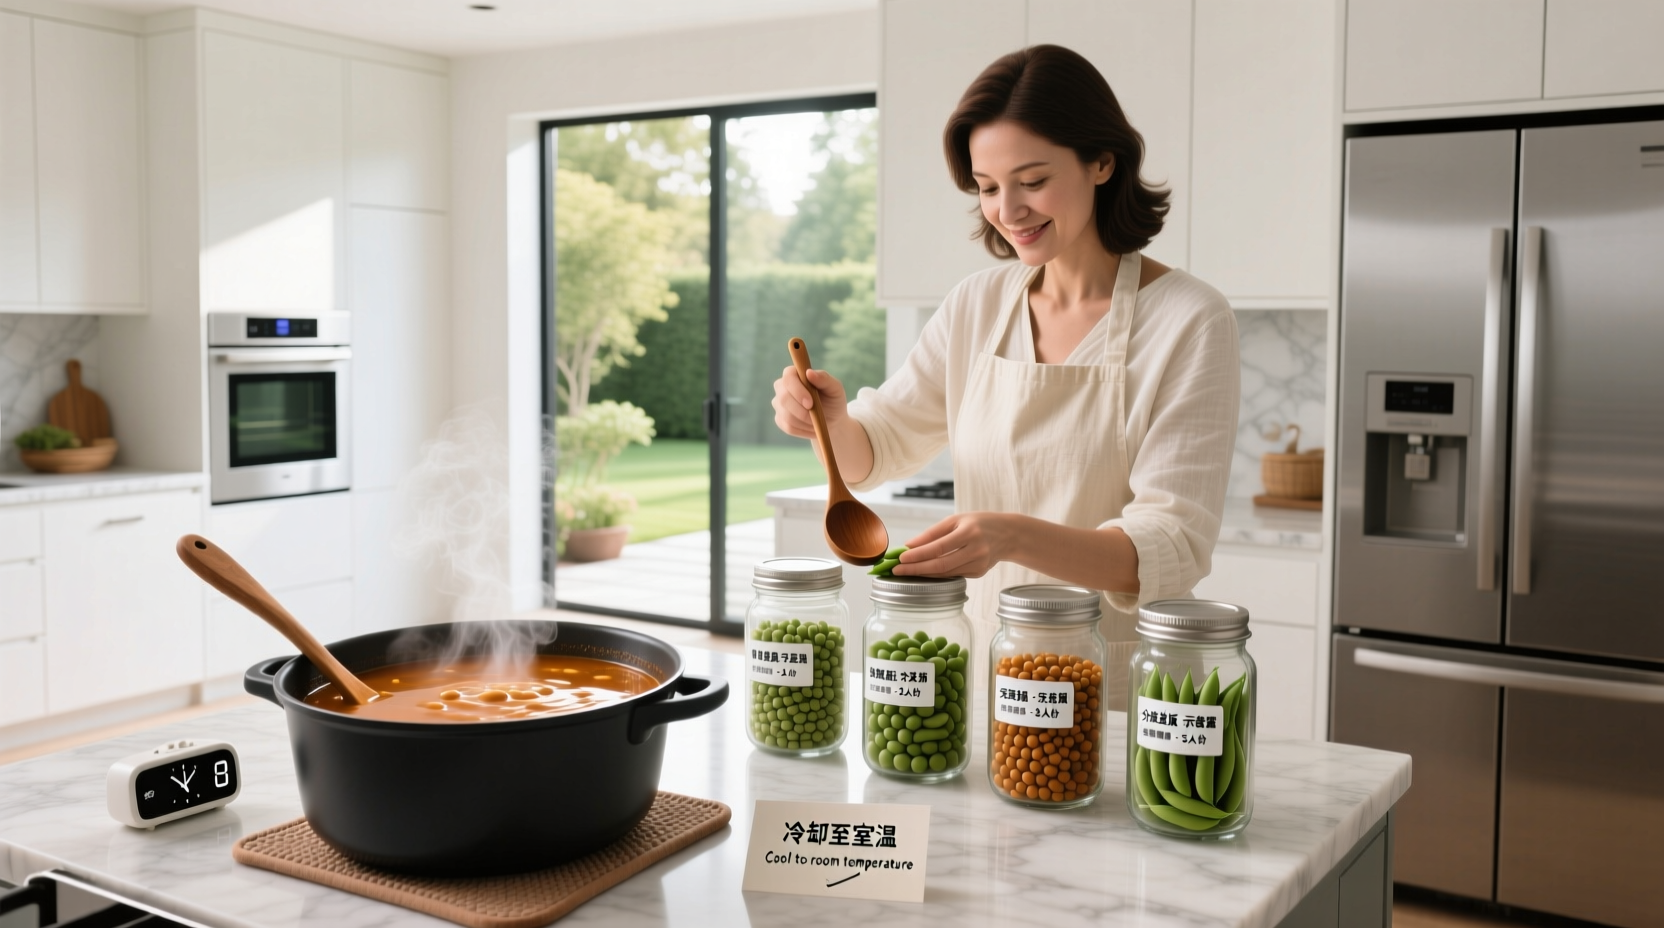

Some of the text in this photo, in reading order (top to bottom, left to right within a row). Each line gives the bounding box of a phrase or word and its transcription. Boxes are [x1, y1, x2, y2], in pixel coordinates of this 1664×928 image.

[783, 820, 897, 848] 冷却至室温
[765, 850, 792, 864] Cool
[795, 853, 808, 865] to
[811, 856, 840, 867] room
